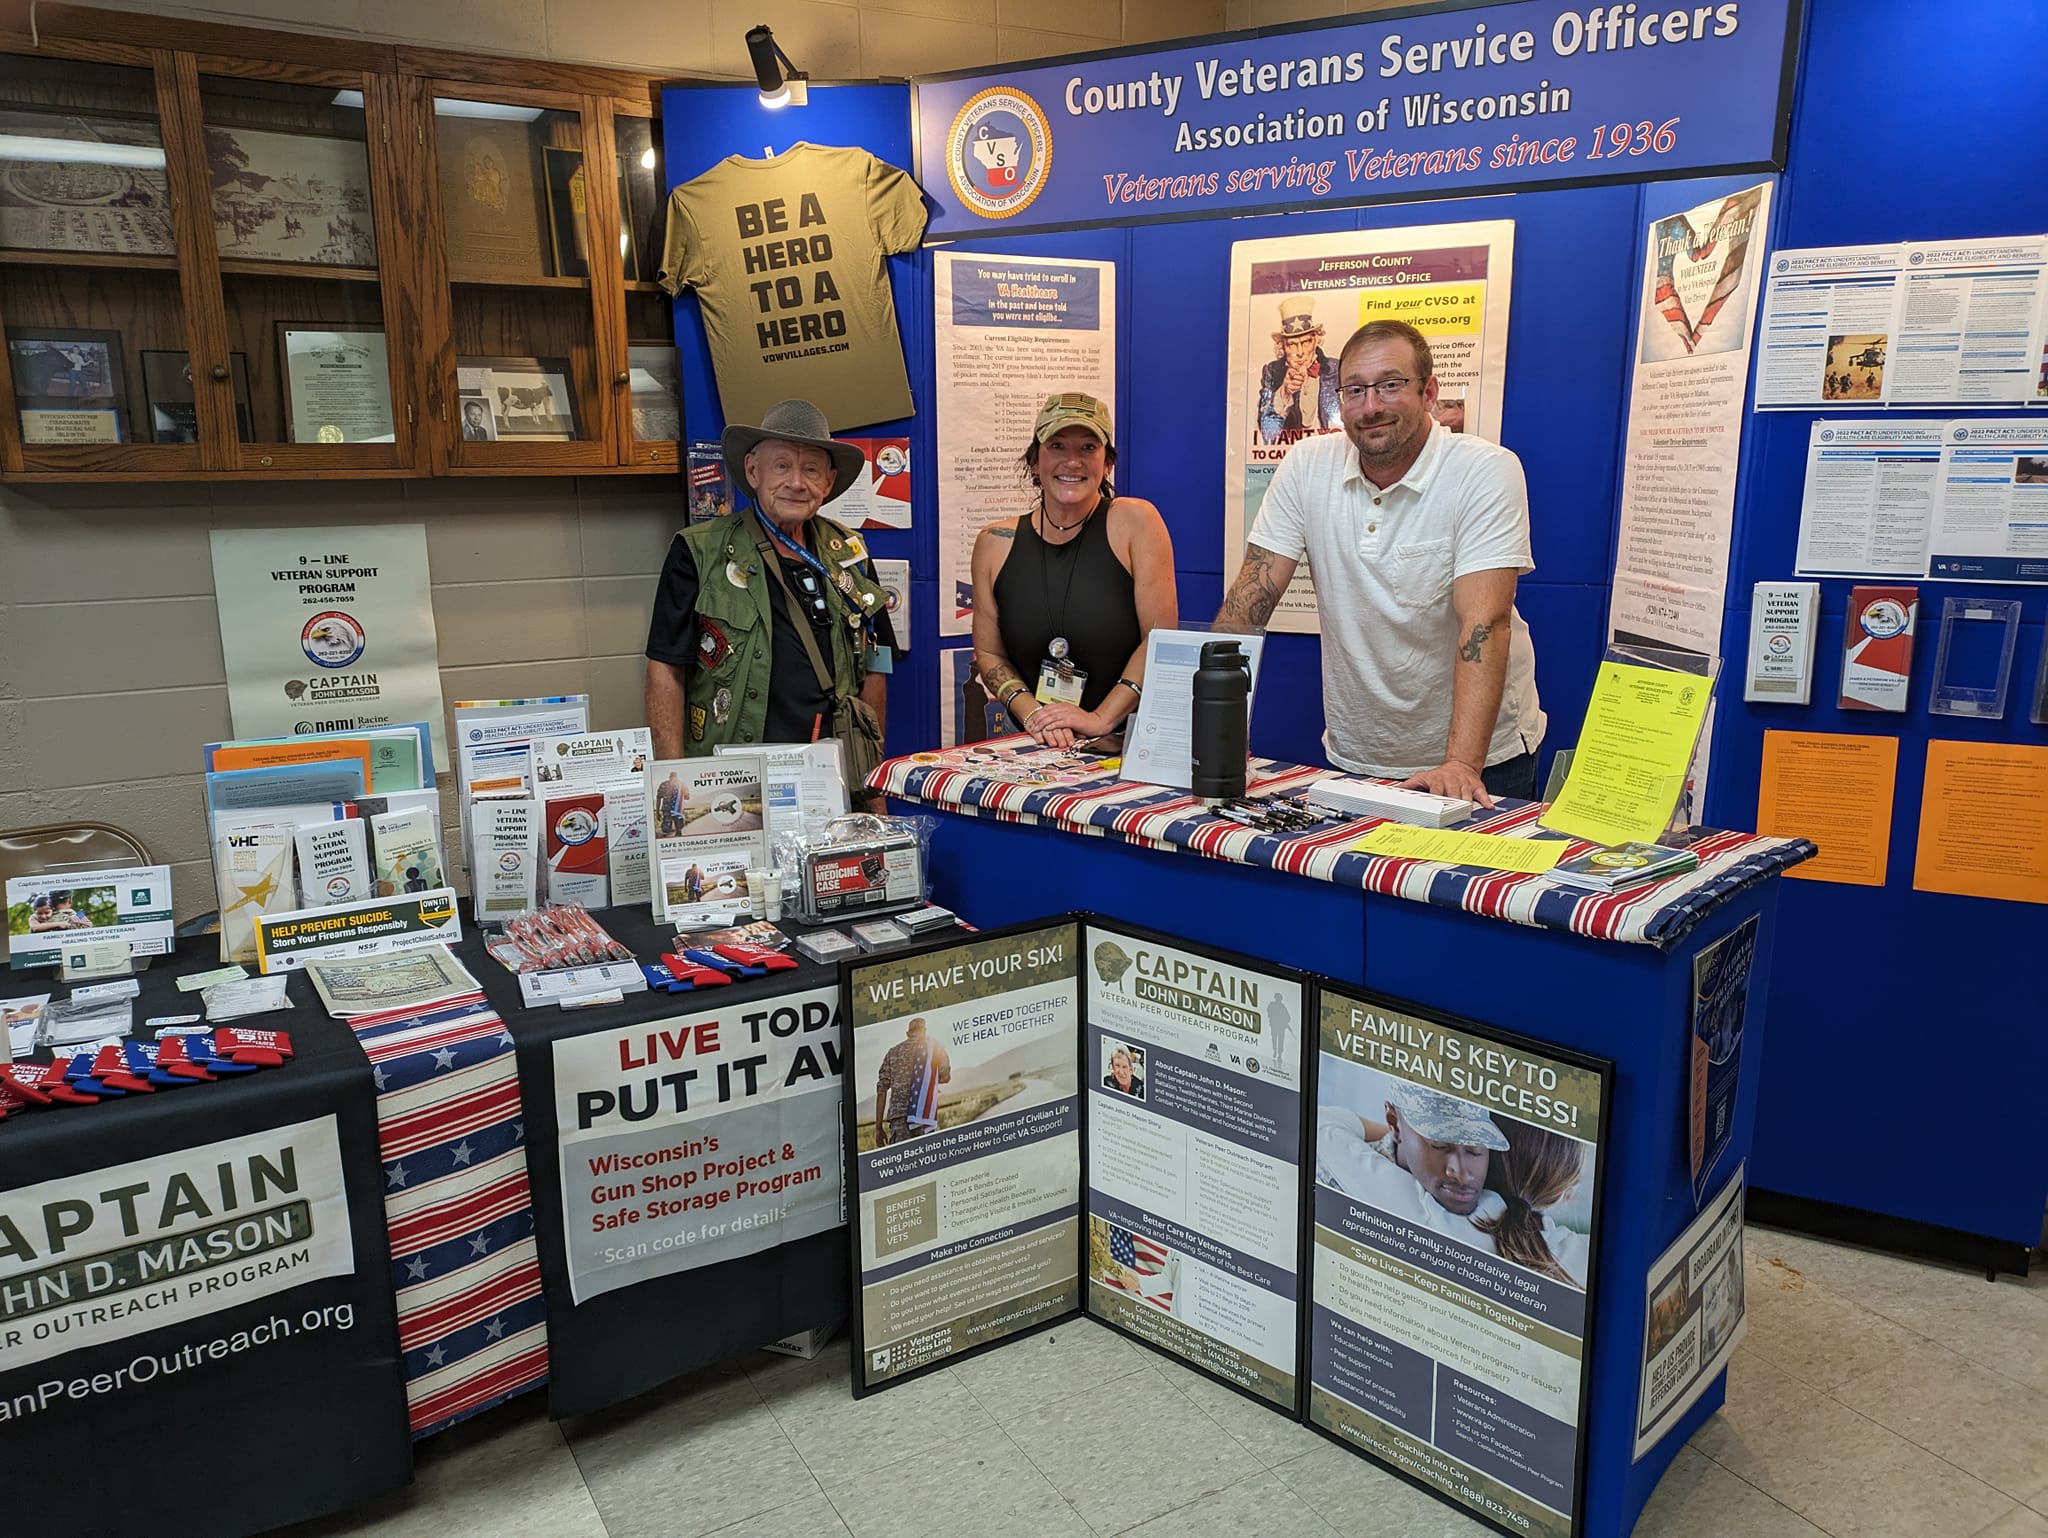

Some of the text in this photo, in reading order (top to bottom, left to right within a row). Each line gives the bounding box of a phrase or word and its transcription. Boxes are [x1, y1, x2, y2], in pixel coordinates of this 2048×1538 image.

[1065, 1, 1738, 117] County Veterans Service Officers
[955, 97, 1044, 161] COUNTY VETERANS SERVICE OFFICERS
[1174, 80, 1570, 153] Association of Wisconsin
[1103, 116, 1680, 205] Veterans serving Veterans since 1936
[960, 168, 1040, 208] ASSOCIATION OF WISCONSIN
[735, 192, 827, 239] BE A
[1657, 229, 1692, 259] Thank
[1702, 208, 1754, 249] Veteran!
[743, 234, 833, 274] HERO
[750, 270, 840, 313] TO A
[978, 268, 990, 279] You
[992, 271, 1006, 281] may
[1008, 270, 1024, 281] have
[1025, 271, 1041, 282] tried
[1042, 273, 1049, 282] to
[1050, 274, 1068, 284] enroll
[998, 283, 1058, 299] VA Healthcare
[1367, 295, 1476, 310] Find your CVSO at
[756, 310, 846, 348] HERO
[1451, 342, 1475, 350] Officer
[762, 342, 849, 363] VOWVILLAGES.COM
[1456, 371, 1480, 379] access
[271, 567, 378, 582] VETERAN SUPPORT
[299, 554, 350, 565] 9 LINE
[298, 583, 355, 595] PROGRAM
[302, 595, 354, 605] 262-456-7059
[309, 673, 378, 689] CAPTAIN
[313, 685, 377, 700] JOHN D. MASON
[694, 775, 758, 787] PUT IT AWAY!
[700, 771, 717, 779] LIVE
[228, 835, 259, 848] VHC
[815, 863, 840, 873] LOCKING
[816, 867, 860, 883] MEDICINE
[816, 880, 841, 893] CASE
[422, 899, 437, 909] OWN
[271, 911, 393, 939] HELP PREVENT SUICIDE:
[272, 919, 408, 949] Store Your Firearms Responsibly
[358, 929, 457, 951] NSSF ProjectChildSafe.org
[869, 944, 1063, 1003] WE HAVE YOUR SIX!
[1135, 950, 1259, 1009] CAPTAIN
[952, 995, 1068, 1031] WE SERVED TOGETHER
[1100, 990, 1259, 1047] VETERAN PEER OUTREACH PROGRAM
[1140, 982, 1254, 1030] JOHN D. MASON
[619, 1021, 722, 1072] LIVE
[952, 1013, 1055, 1046] WE HEAL TOGETHER
[1351, 1008, 1557, 1092] FAMILY IS KEY TO
[576, 1069, 699, 1131] PUT
[716, 1054, 768, 1104] IT
[1336, 1030, 1579, 1129] VETERAN SUCCESS!
[870, 1104, 1070, 1169] Getting Back into the Battle Rhythm of Civilian Life
[878, 1118, 1063, 1178] We Want YOU to Know How to Get VA Support!
[588, 1136, 720, 1178] Wisconsin's
[590, 1143, 796, 1205] Gun Shop Project &
[0, 1145, 300, 1264] APTAIN
[592, 1164, 822, 1233] Safe Storage Program
[84, 1210, 293, 1293] D. MASON
[653, 1228, 698, 1252] code
[699, 1219, 728, 1248] for
[931, 1228, 1014, 1260] Make the Connection
[33, 1248, 310, 1341] OUTREACH PROGRAM
[0, 1303, 355, 1422] anPeerOutreach.org
